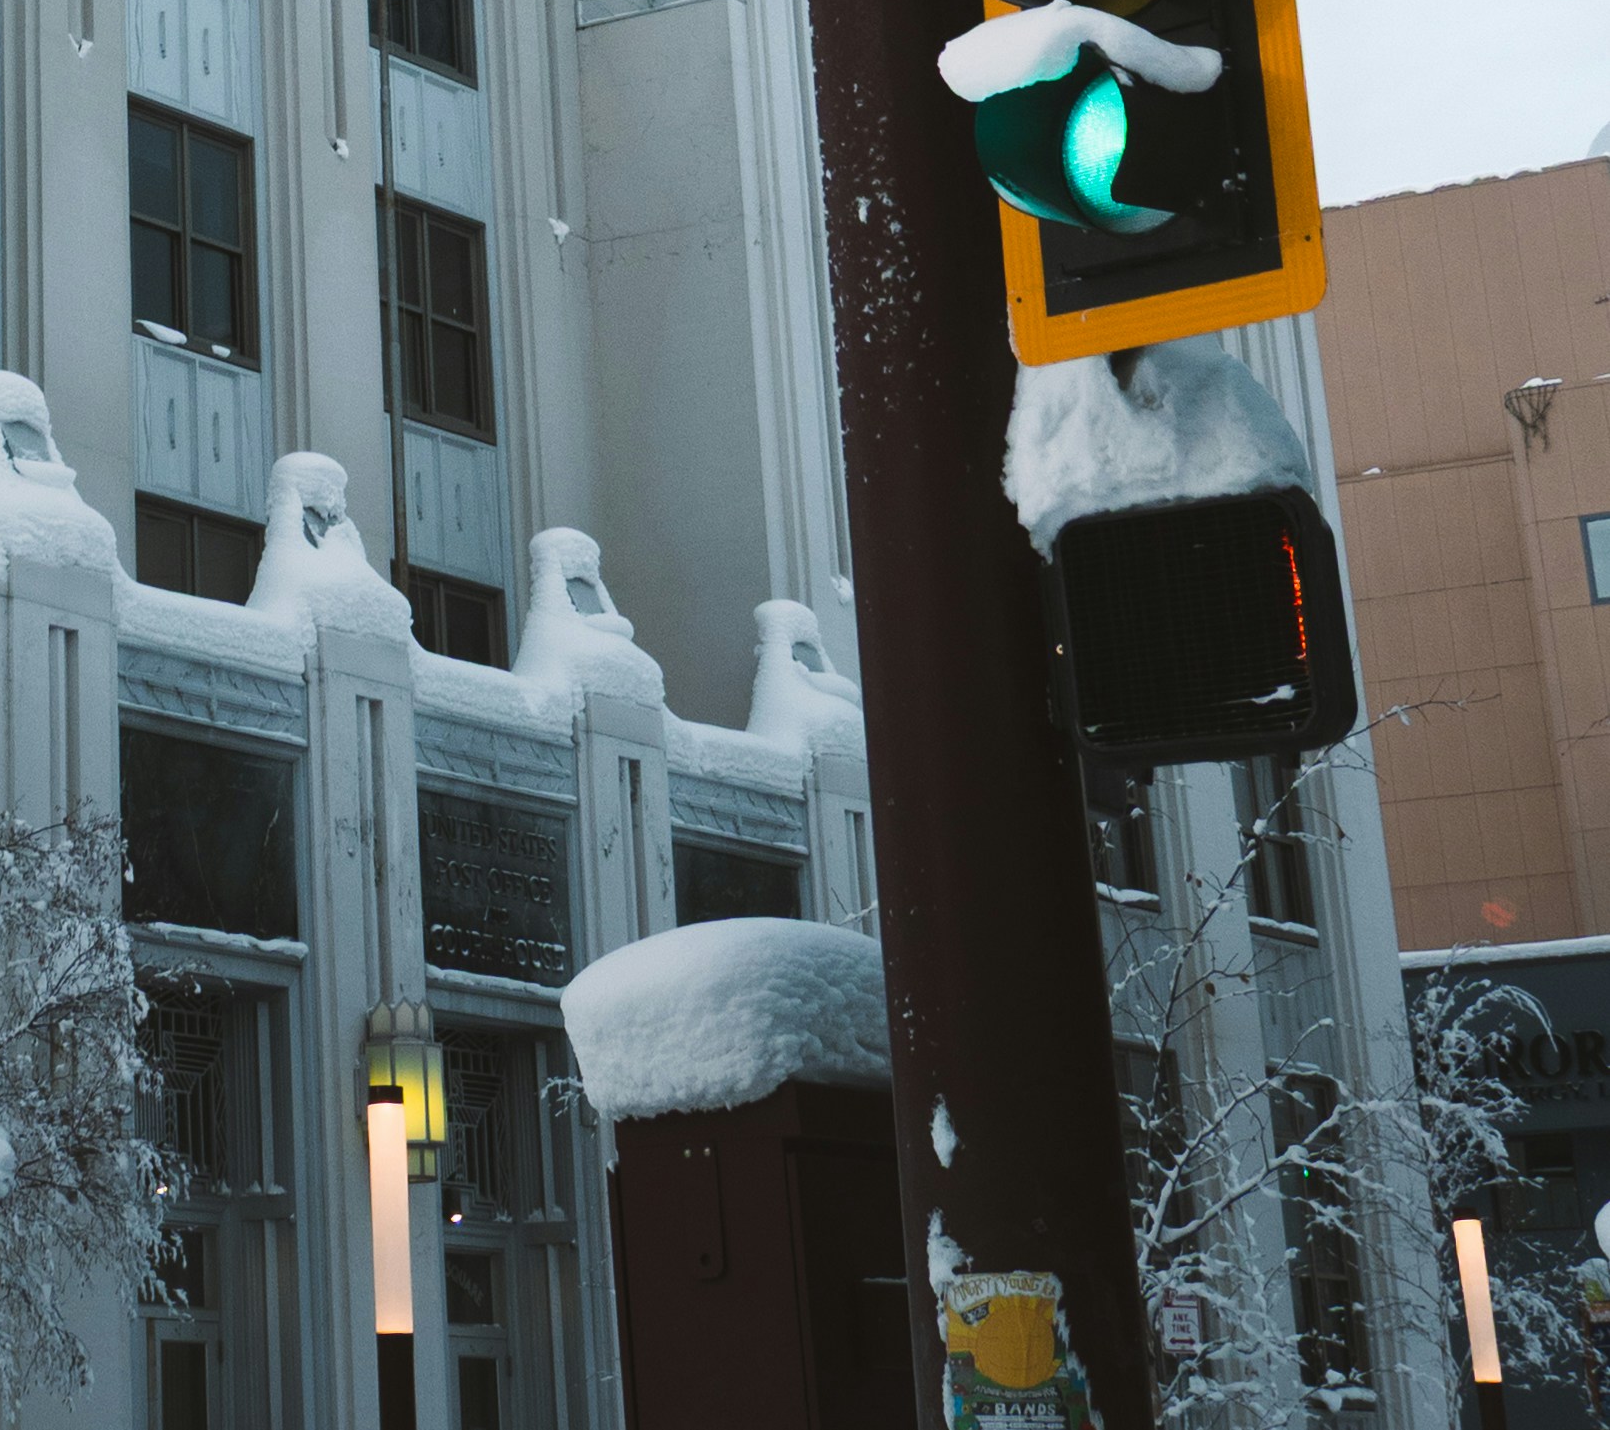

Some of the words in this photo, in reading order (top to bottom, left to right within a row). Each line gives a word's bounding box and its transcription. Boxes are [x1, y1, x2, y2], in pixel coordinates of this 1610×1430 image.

[423, 810, 493, 850] UNITED
[497, 827, 559, 863] STATES
[435, 855, 482, 890] POST
[487, 867, 552, 904] OFFICE
[501, 936, 567, 972] HOUSE
[994, 1402, 1057, 1416] BANDS
